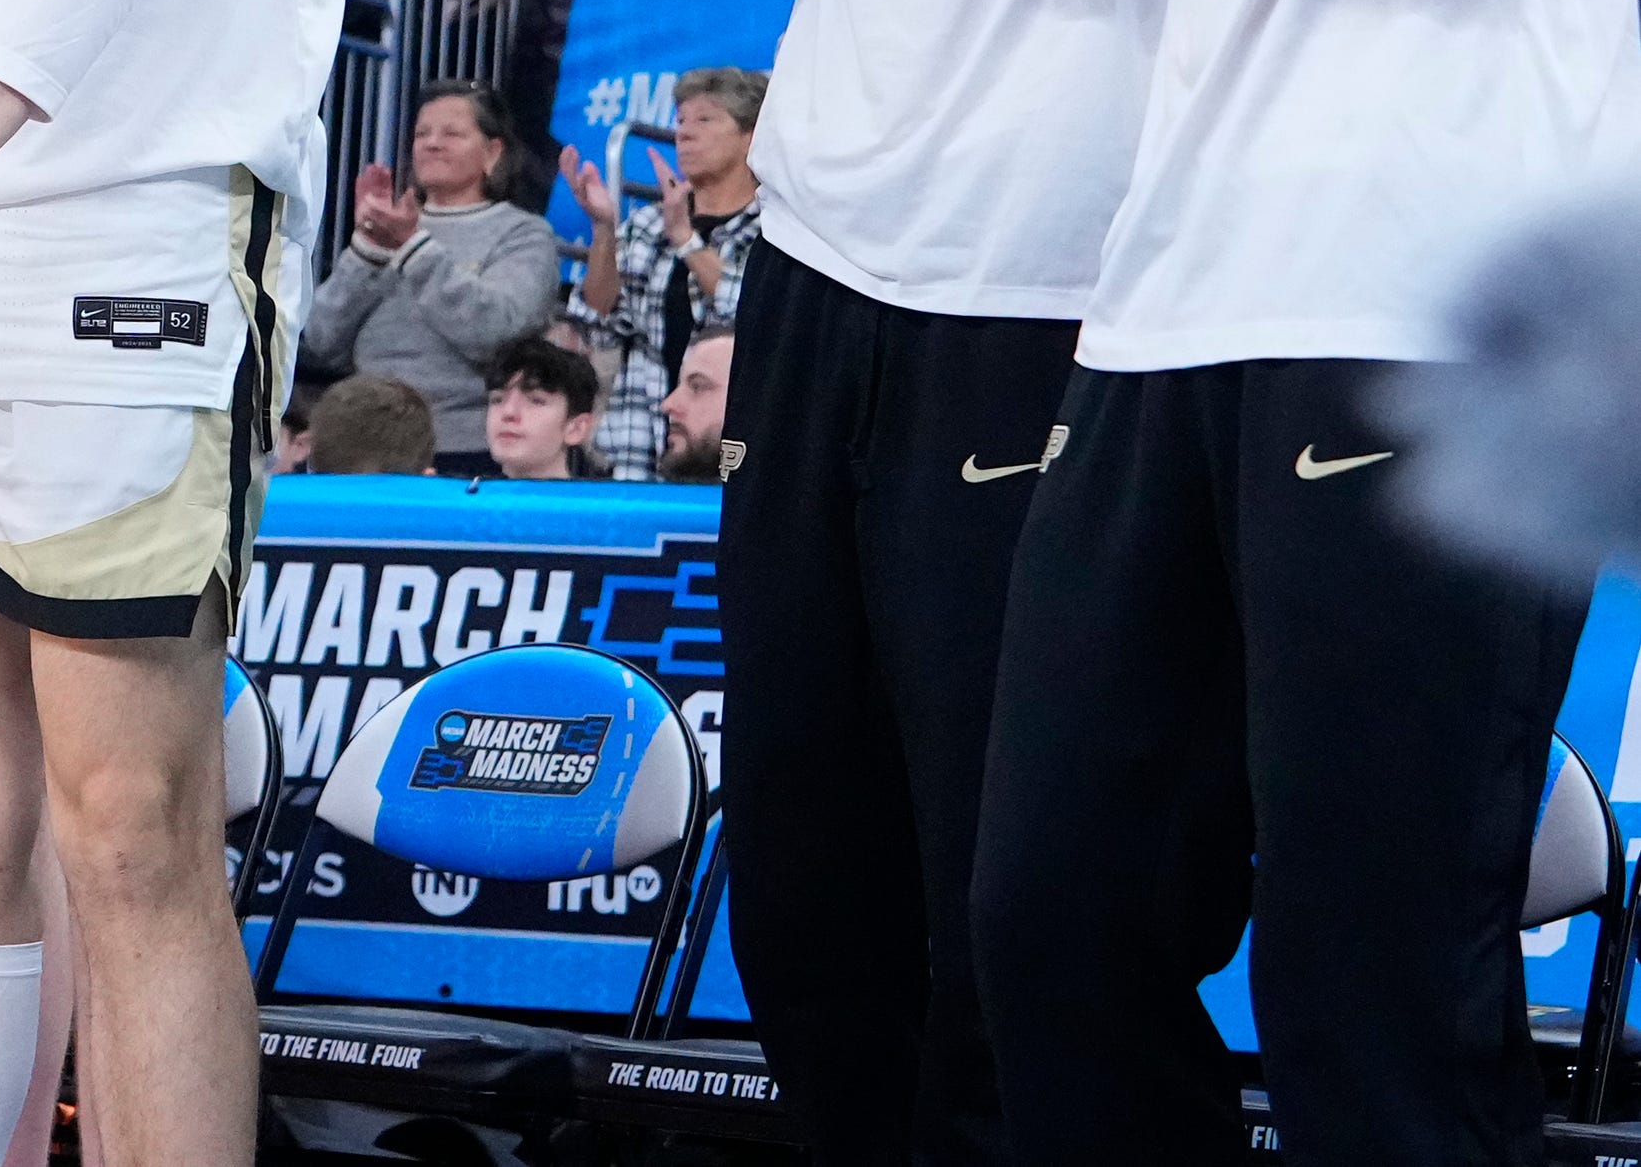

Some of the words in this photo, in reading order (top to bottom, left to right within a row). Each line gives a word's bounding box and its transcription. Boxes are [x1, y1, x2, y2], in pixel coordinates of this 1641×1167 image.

[170, 312, 191, 330] 52
[238, 561, 575, 668] MARCH
[463, 718, 562, 752] MARCH
[468, 749, 599, 783] MADNESS
[281, 1035, 317, 1059] THE
[317, 1039, 368, 1064] FINAL
[371, 1044, 422, 1070] FOUR
[608, 1062, 644, 1087] THE
[645, 1066, 700, 1094] ROAD
[703, 1072, 729, 1096] TO
[732, 1074, 769, 1100] THE
